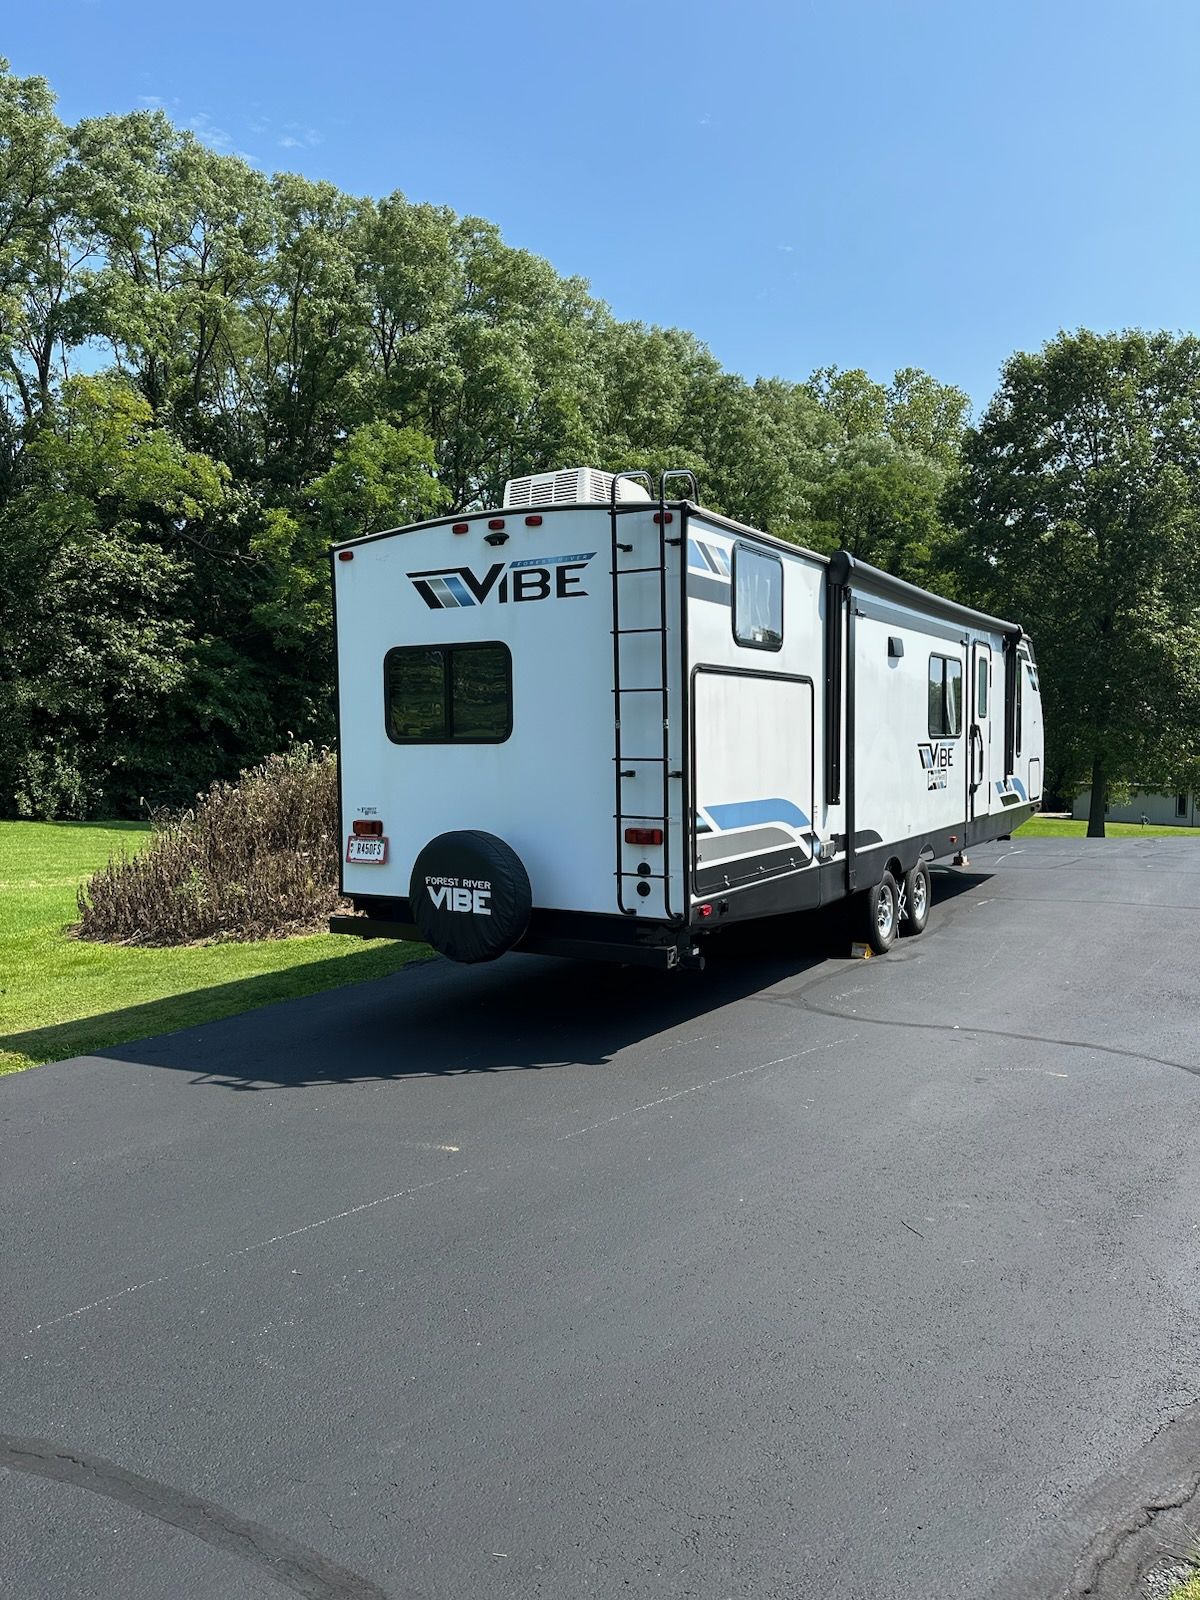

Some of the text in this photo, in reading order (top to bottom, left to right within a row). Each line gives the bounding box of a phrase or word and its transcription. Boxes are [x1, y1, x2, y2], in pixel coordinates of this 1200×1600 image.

[406, 562, 589, 605] VIBE
[917, 742, 954, 768] VIBE
[425, 876, 491, 890] FOREST RIVER
[426, 885, 492, 916] VIBE
